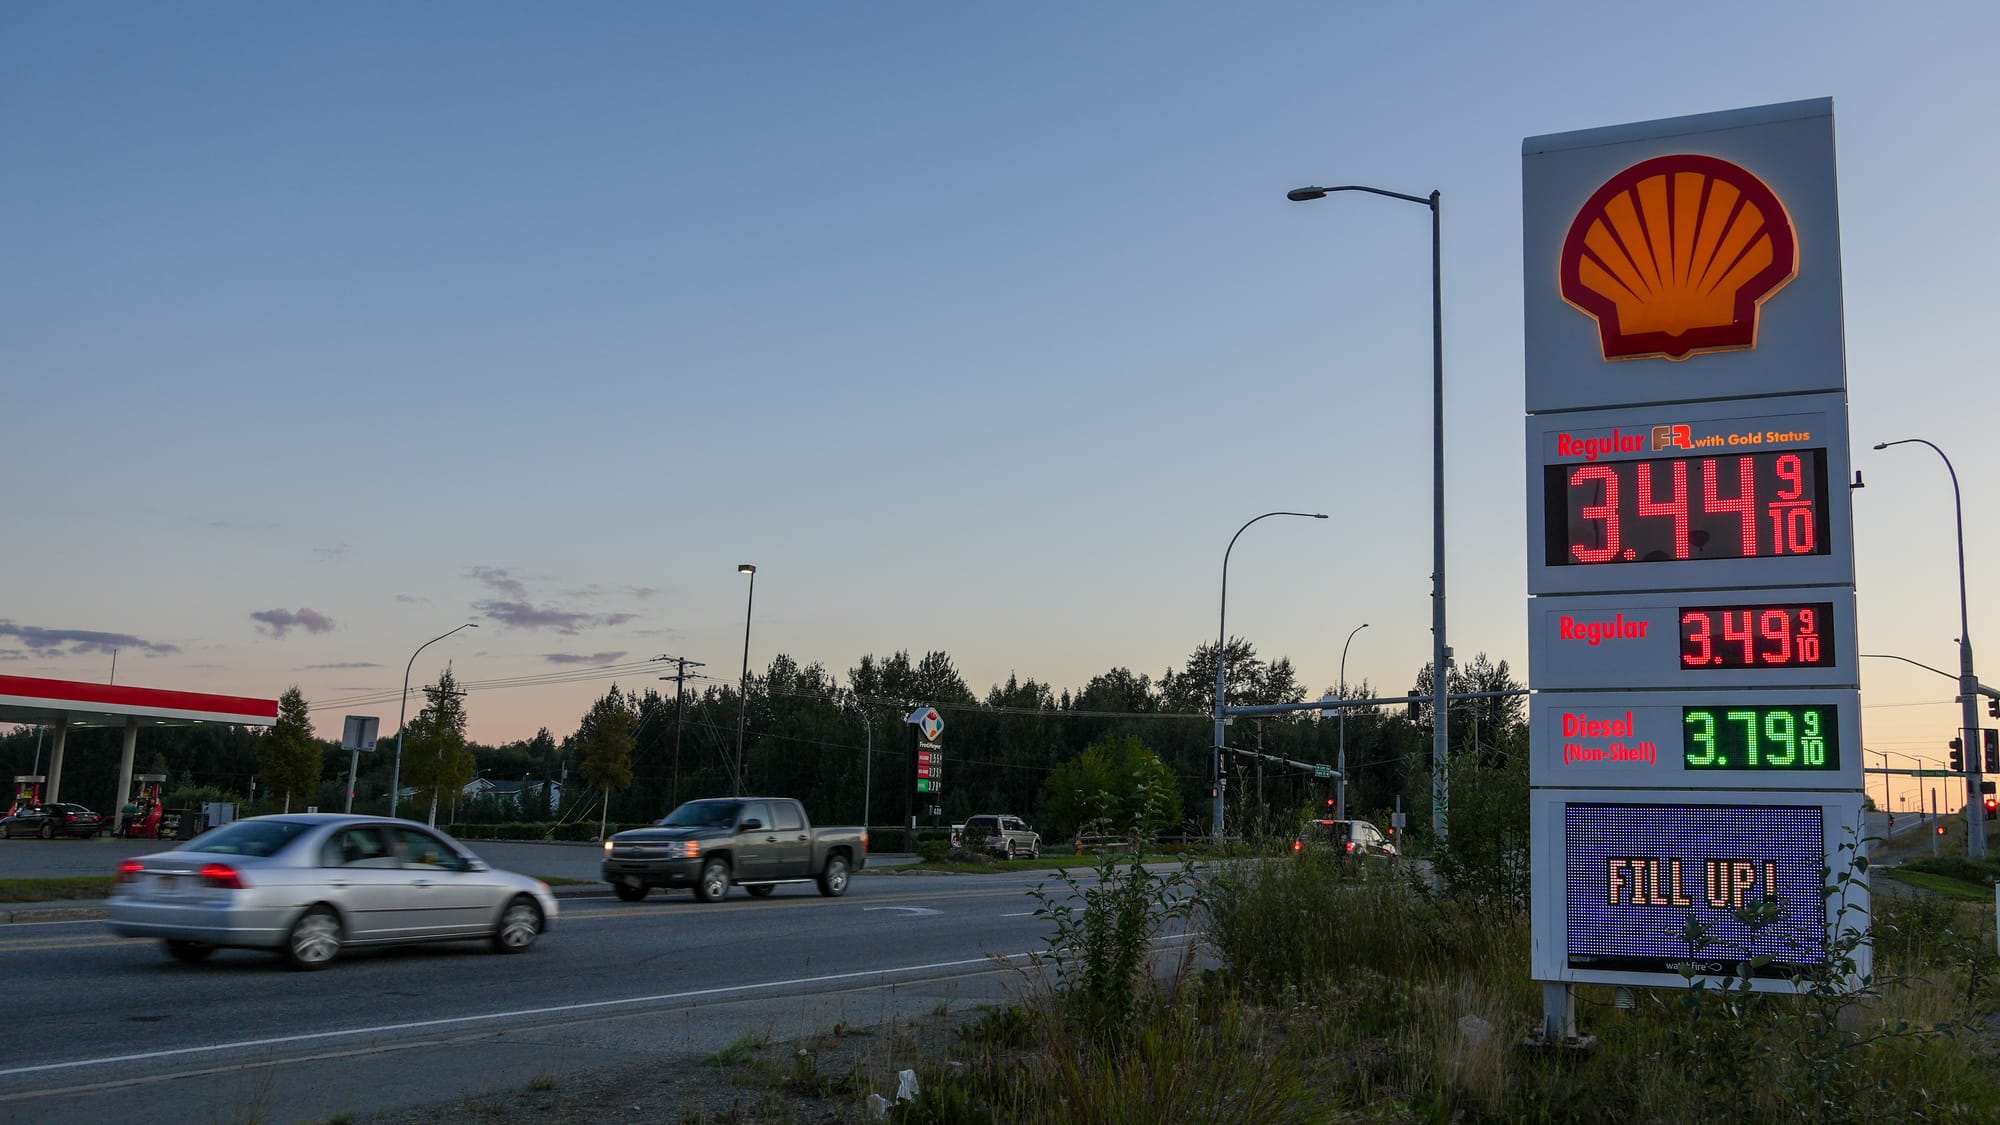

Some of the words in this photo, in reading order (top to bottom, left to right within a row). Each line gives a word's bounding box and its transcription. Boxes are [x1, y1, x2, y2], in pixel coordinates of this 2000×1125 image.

[1558, 428, 1644, 461] Regular
[1695, 434, 1725, 448] with
[1728, 432, 1762, 446] Gold
[1766, 430, 1810, 443] Status
[1570, 457, 1756, 562] 3.44
[1560, 613, 1648, 646] Regular
[1682, 610, 1791, 665] 3.49
[1562, 711, 1633, 738] Diesel
[1686, 711, 1795, 765] 3.79
[1563, 742, 1657, 766] (Non-Shell)
[1609, 859, 1692, 906] FILL
[1665, 961, 1706, 971] wafire
